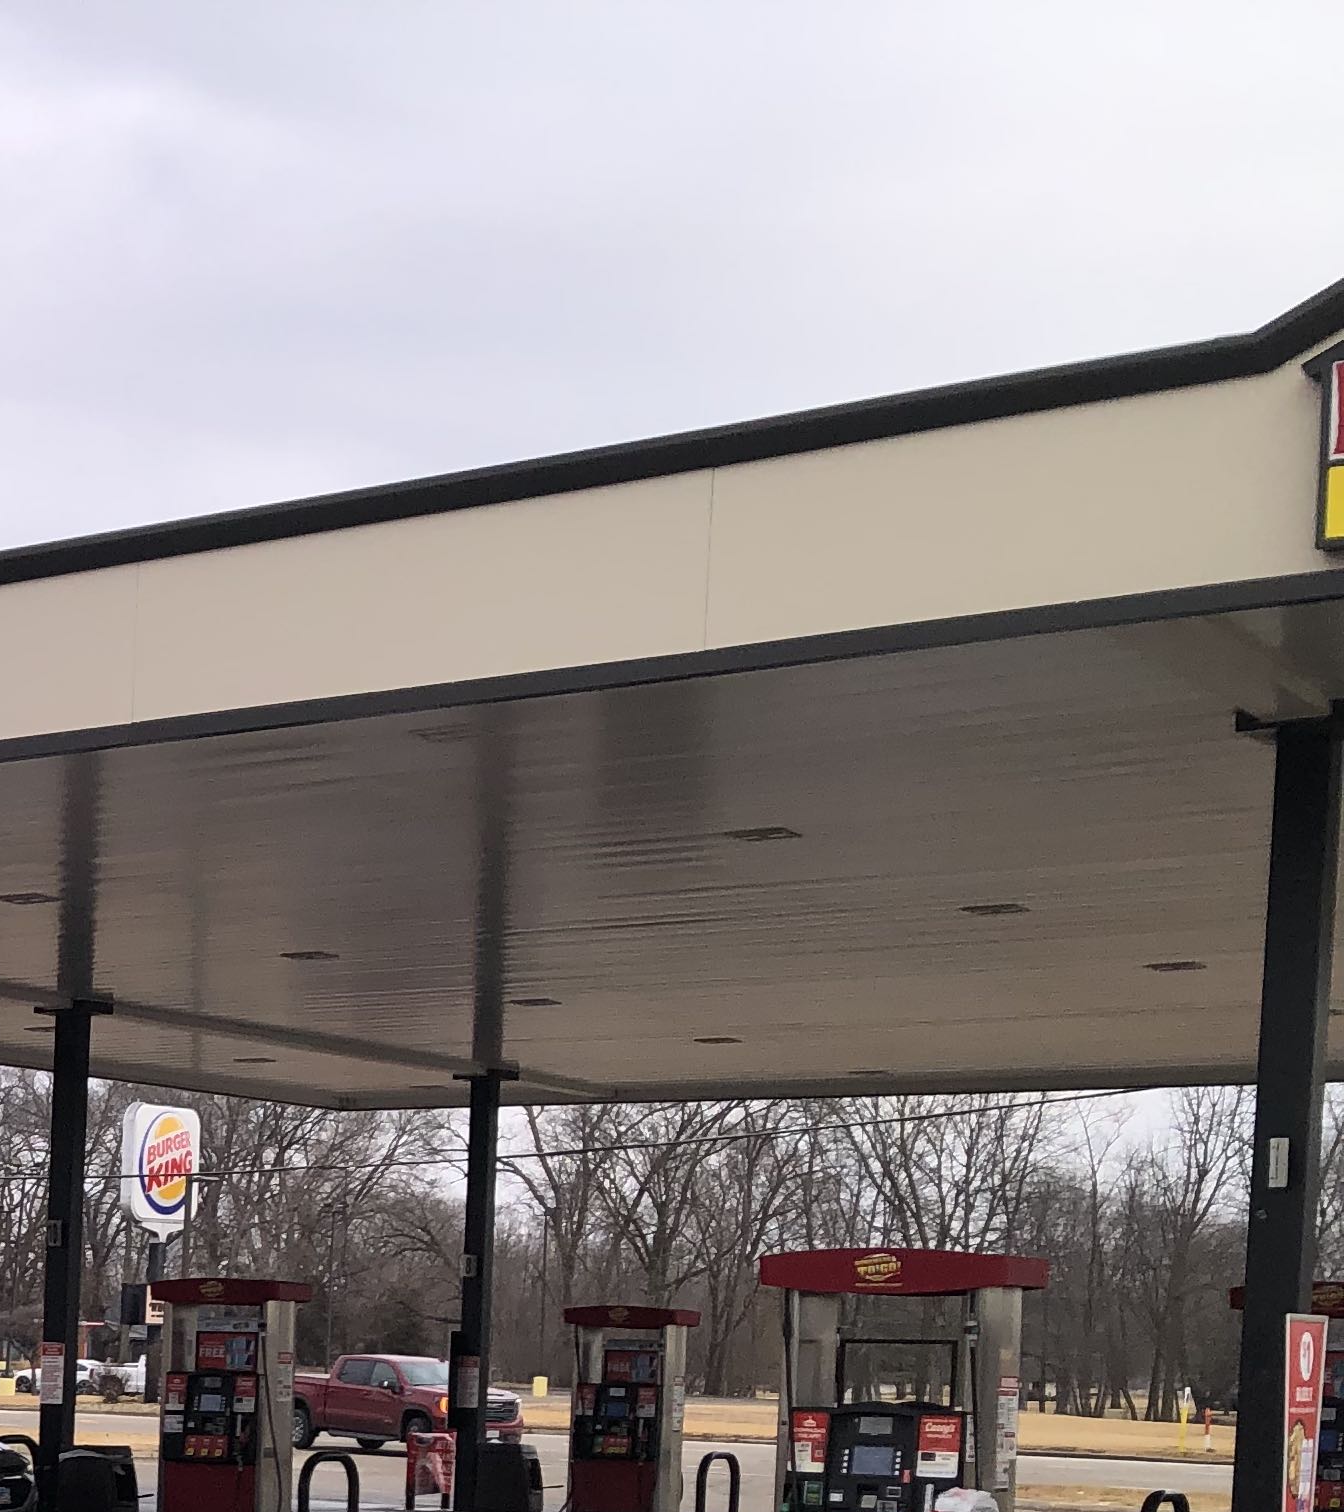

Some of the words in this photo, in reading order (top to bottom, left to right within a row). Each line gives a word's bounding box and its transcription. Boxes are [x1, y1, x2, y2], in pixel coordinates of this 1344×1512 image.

[147, 1130, 191, 1165] BURGER
[146, 1150, 193, 1193] KING
[465, 1257, 472, 1274] 8
[199, 1347, 225, 1358] FREE
